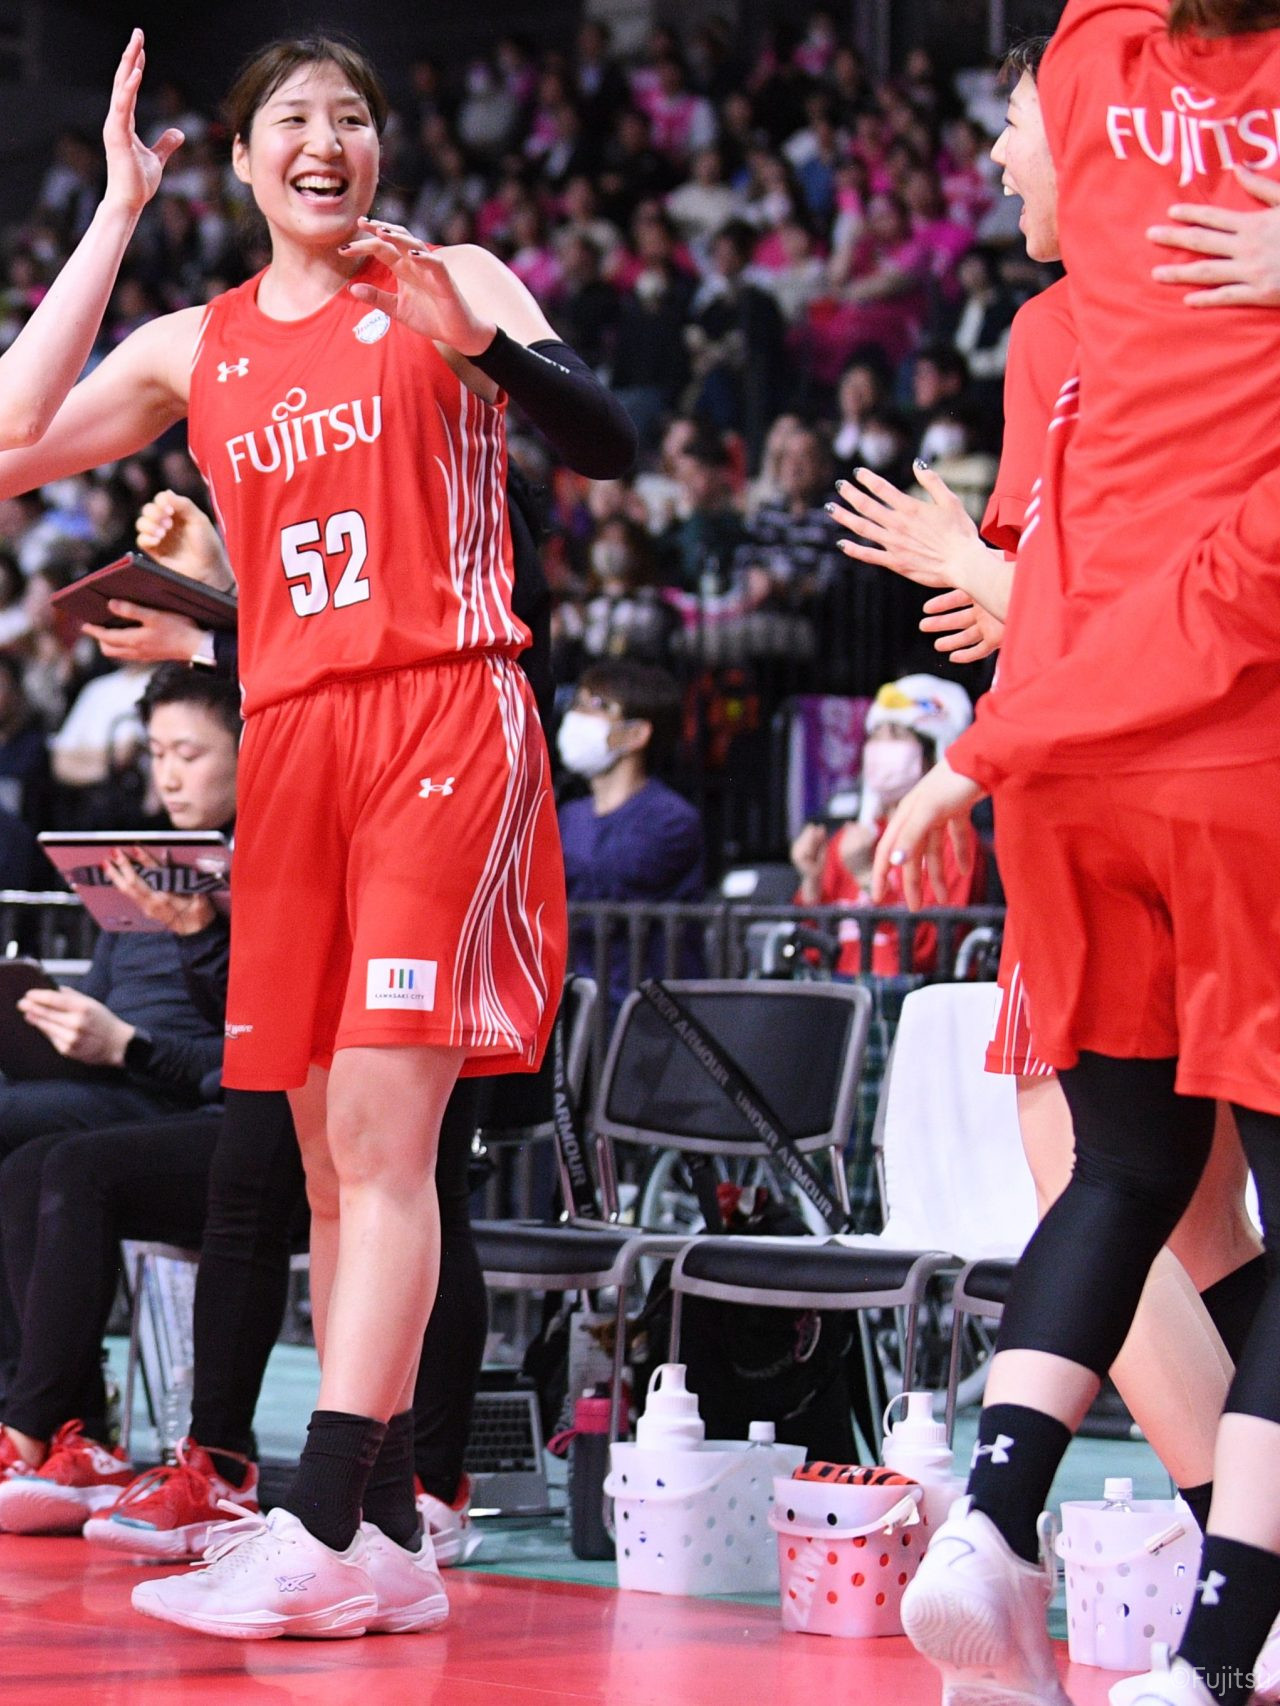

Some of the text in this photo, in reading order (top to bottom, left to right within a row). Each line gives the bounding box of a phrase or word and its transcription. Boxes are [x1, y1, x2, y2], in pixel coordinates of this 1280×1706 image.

[225, 394, 382, 483] FUJITSU
[280, 508, 371, 618] 52
[555, 1091, 588, 1187] ARMOUR
[674, 1019, 731, 1087] ARMOUR
[735, 1089, 779, 1150] UNDER
[777, 1146, 834, 1218] ARMOUR
